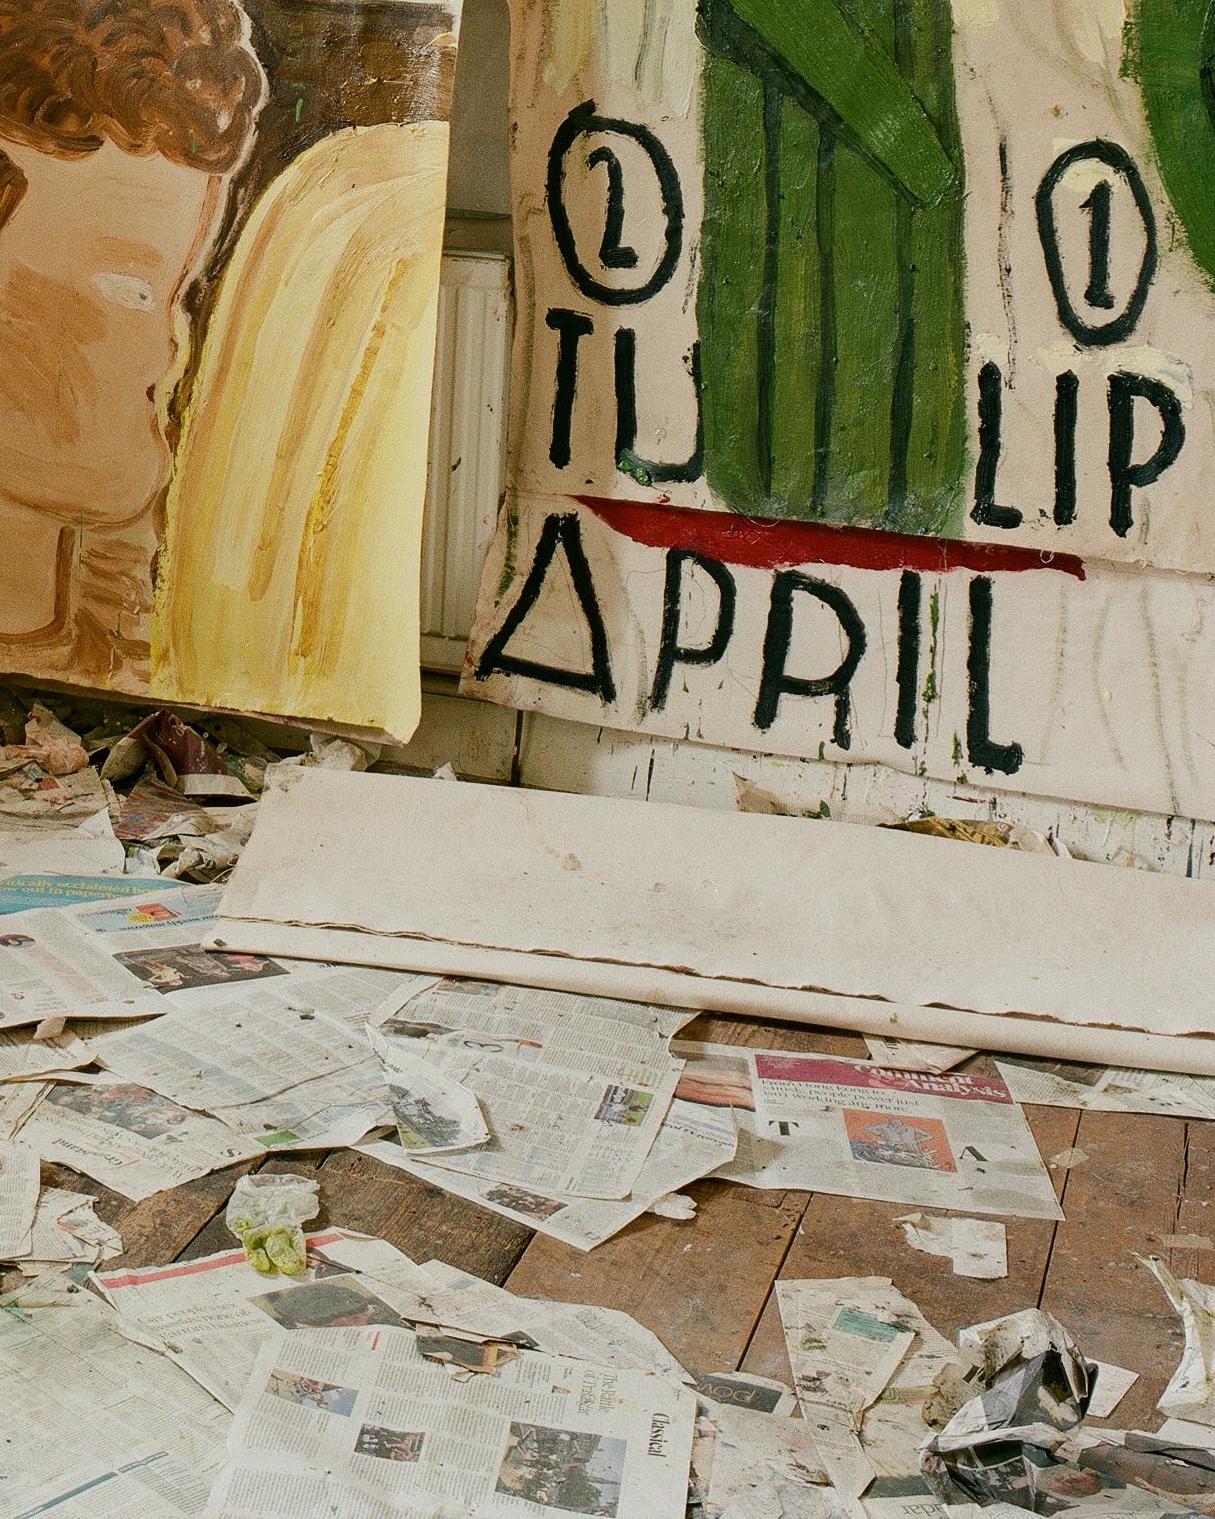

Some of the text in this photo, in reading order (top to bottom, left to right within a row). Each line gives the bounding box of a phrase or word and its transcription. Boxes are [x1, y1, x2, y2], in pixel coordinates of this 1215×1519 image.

[586, 146, 1116, 309] 2 1
[970, 361, 1186, 538] LIP
[474, 511, 1024, 775] APRIL
[790, 1093, 845, 1107] working
[847, 1100, 870, 1110] any
[809, 1088, 851, 1100] people
[854, 1093, 893, 1104] power
[901, 1079, 1007, 1099] Analysis
[648, 1412, 671, 1458] Classical
